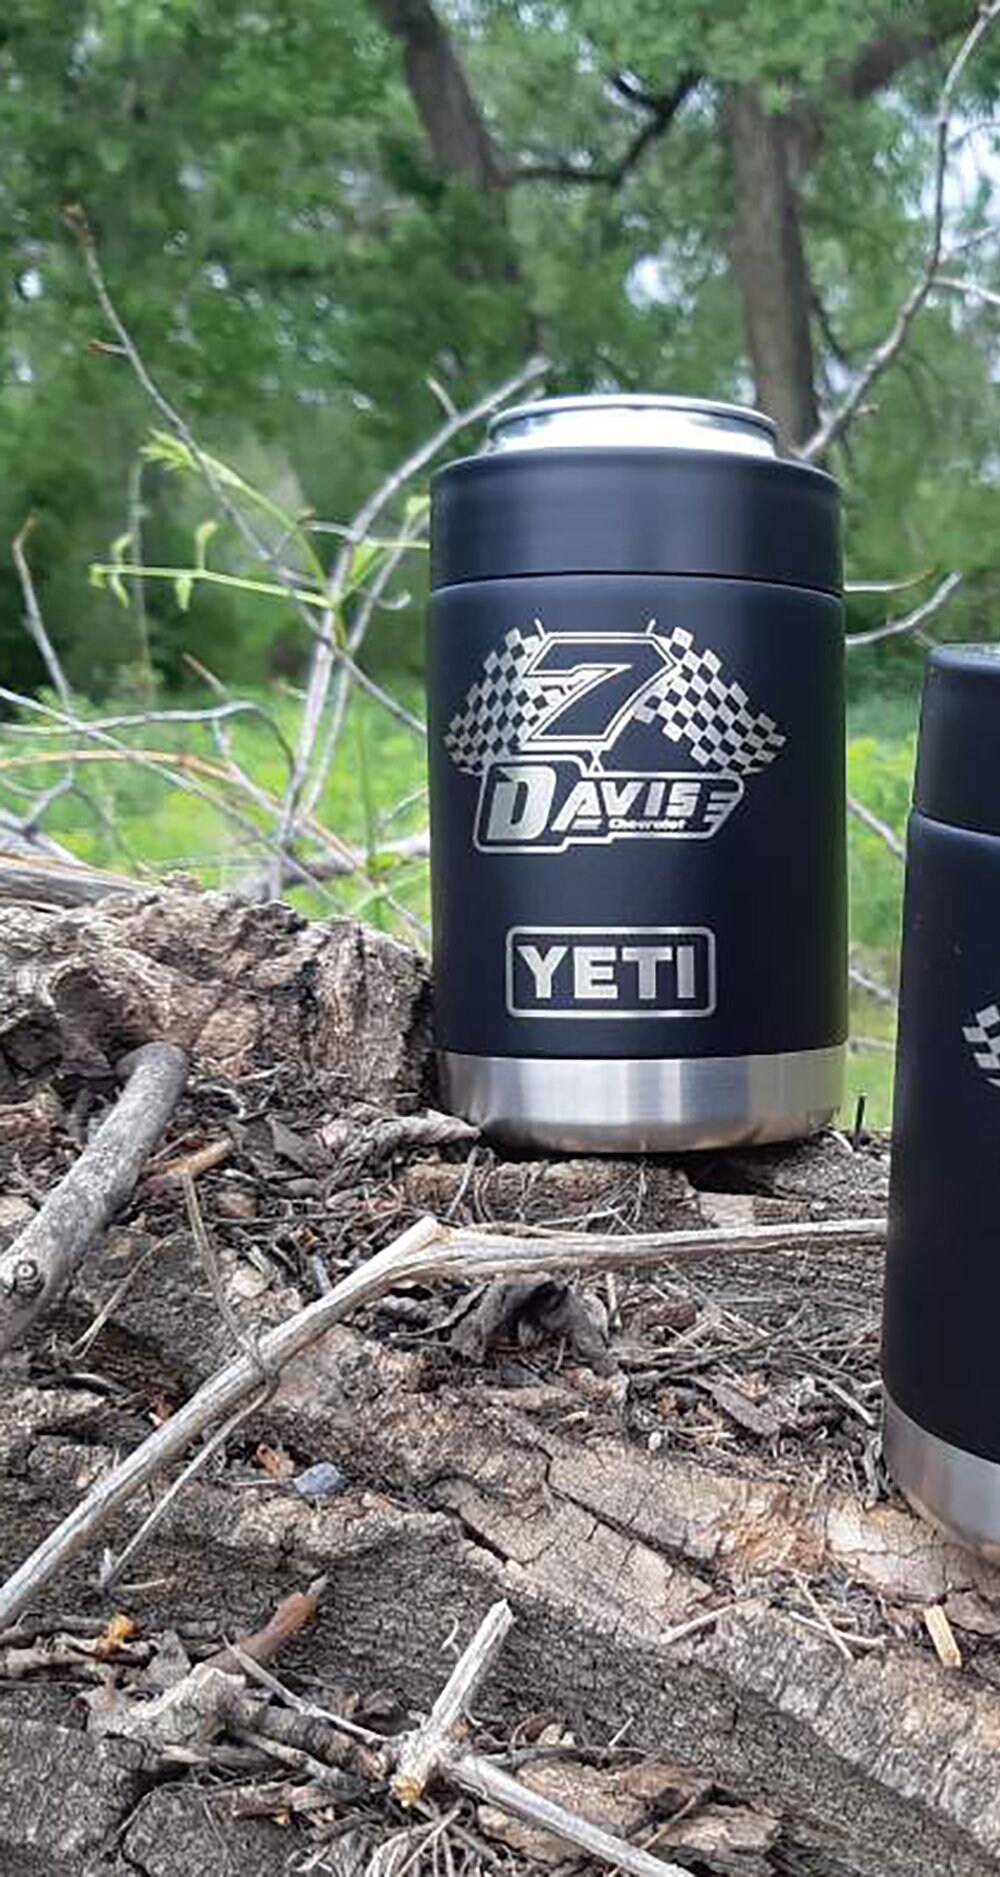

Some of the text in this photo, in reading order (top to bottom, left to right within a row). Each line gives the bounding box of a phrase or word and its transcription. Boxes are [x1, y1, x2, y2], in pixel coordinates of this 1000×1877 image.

[519, 632, 680, 750] 7
[487, 765, 701, 840] DAVIS
[518, 945, 696, 1000] YETI
